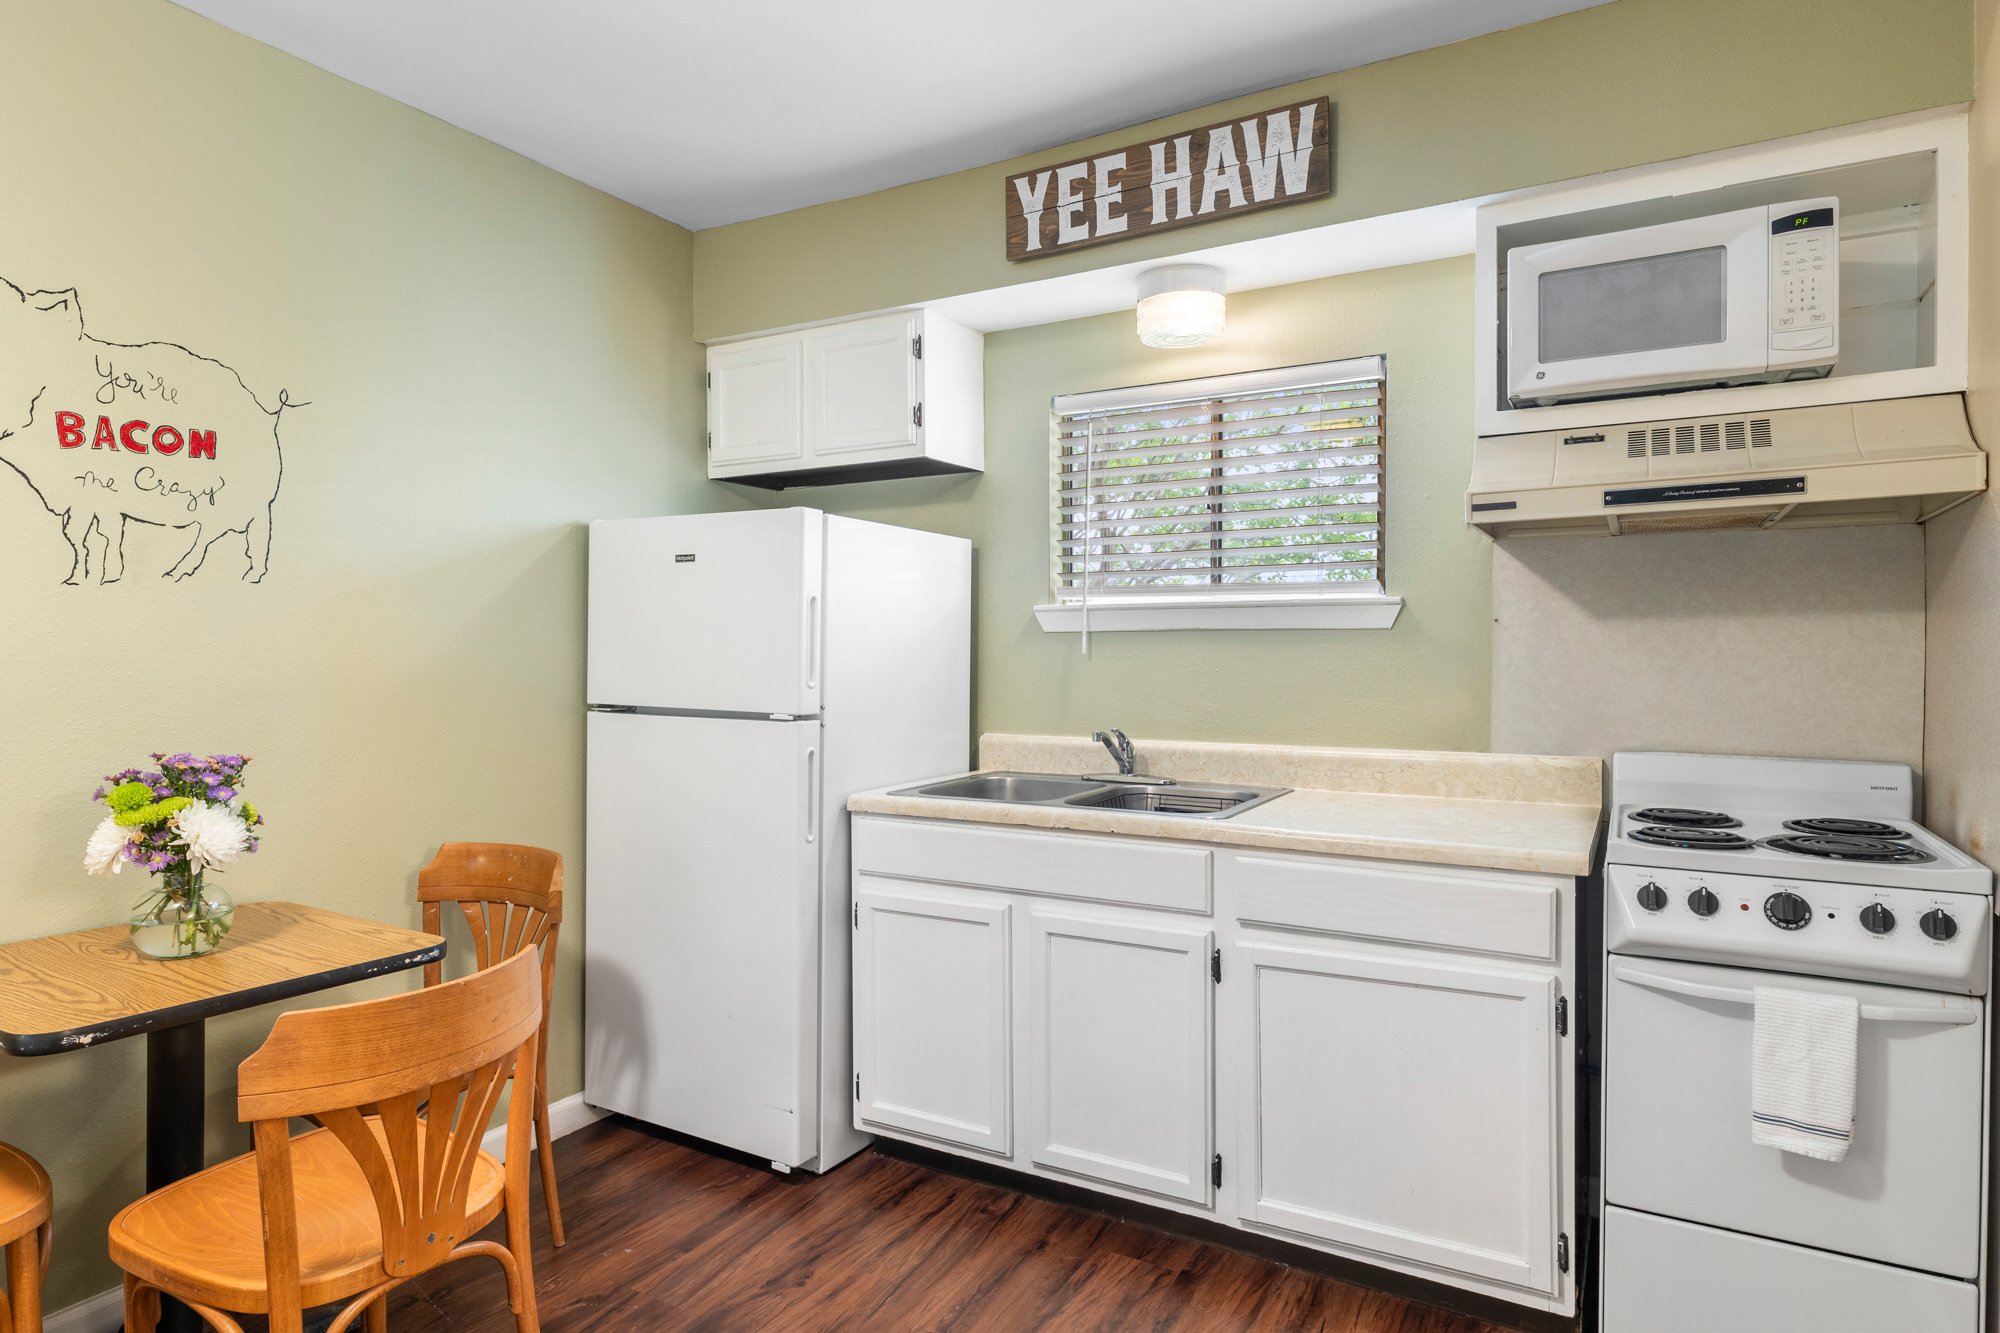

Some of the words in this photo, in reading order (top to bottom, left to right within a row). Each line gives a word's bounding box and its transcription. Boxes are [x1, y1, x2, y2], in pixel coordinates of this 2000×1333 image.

[1013, 152, 1129, 252] YEE
[1149, 103, 1318, 226] HAW
[55, 411, 217, 460] BACON
[134, 466, 225, 512] Crazy
